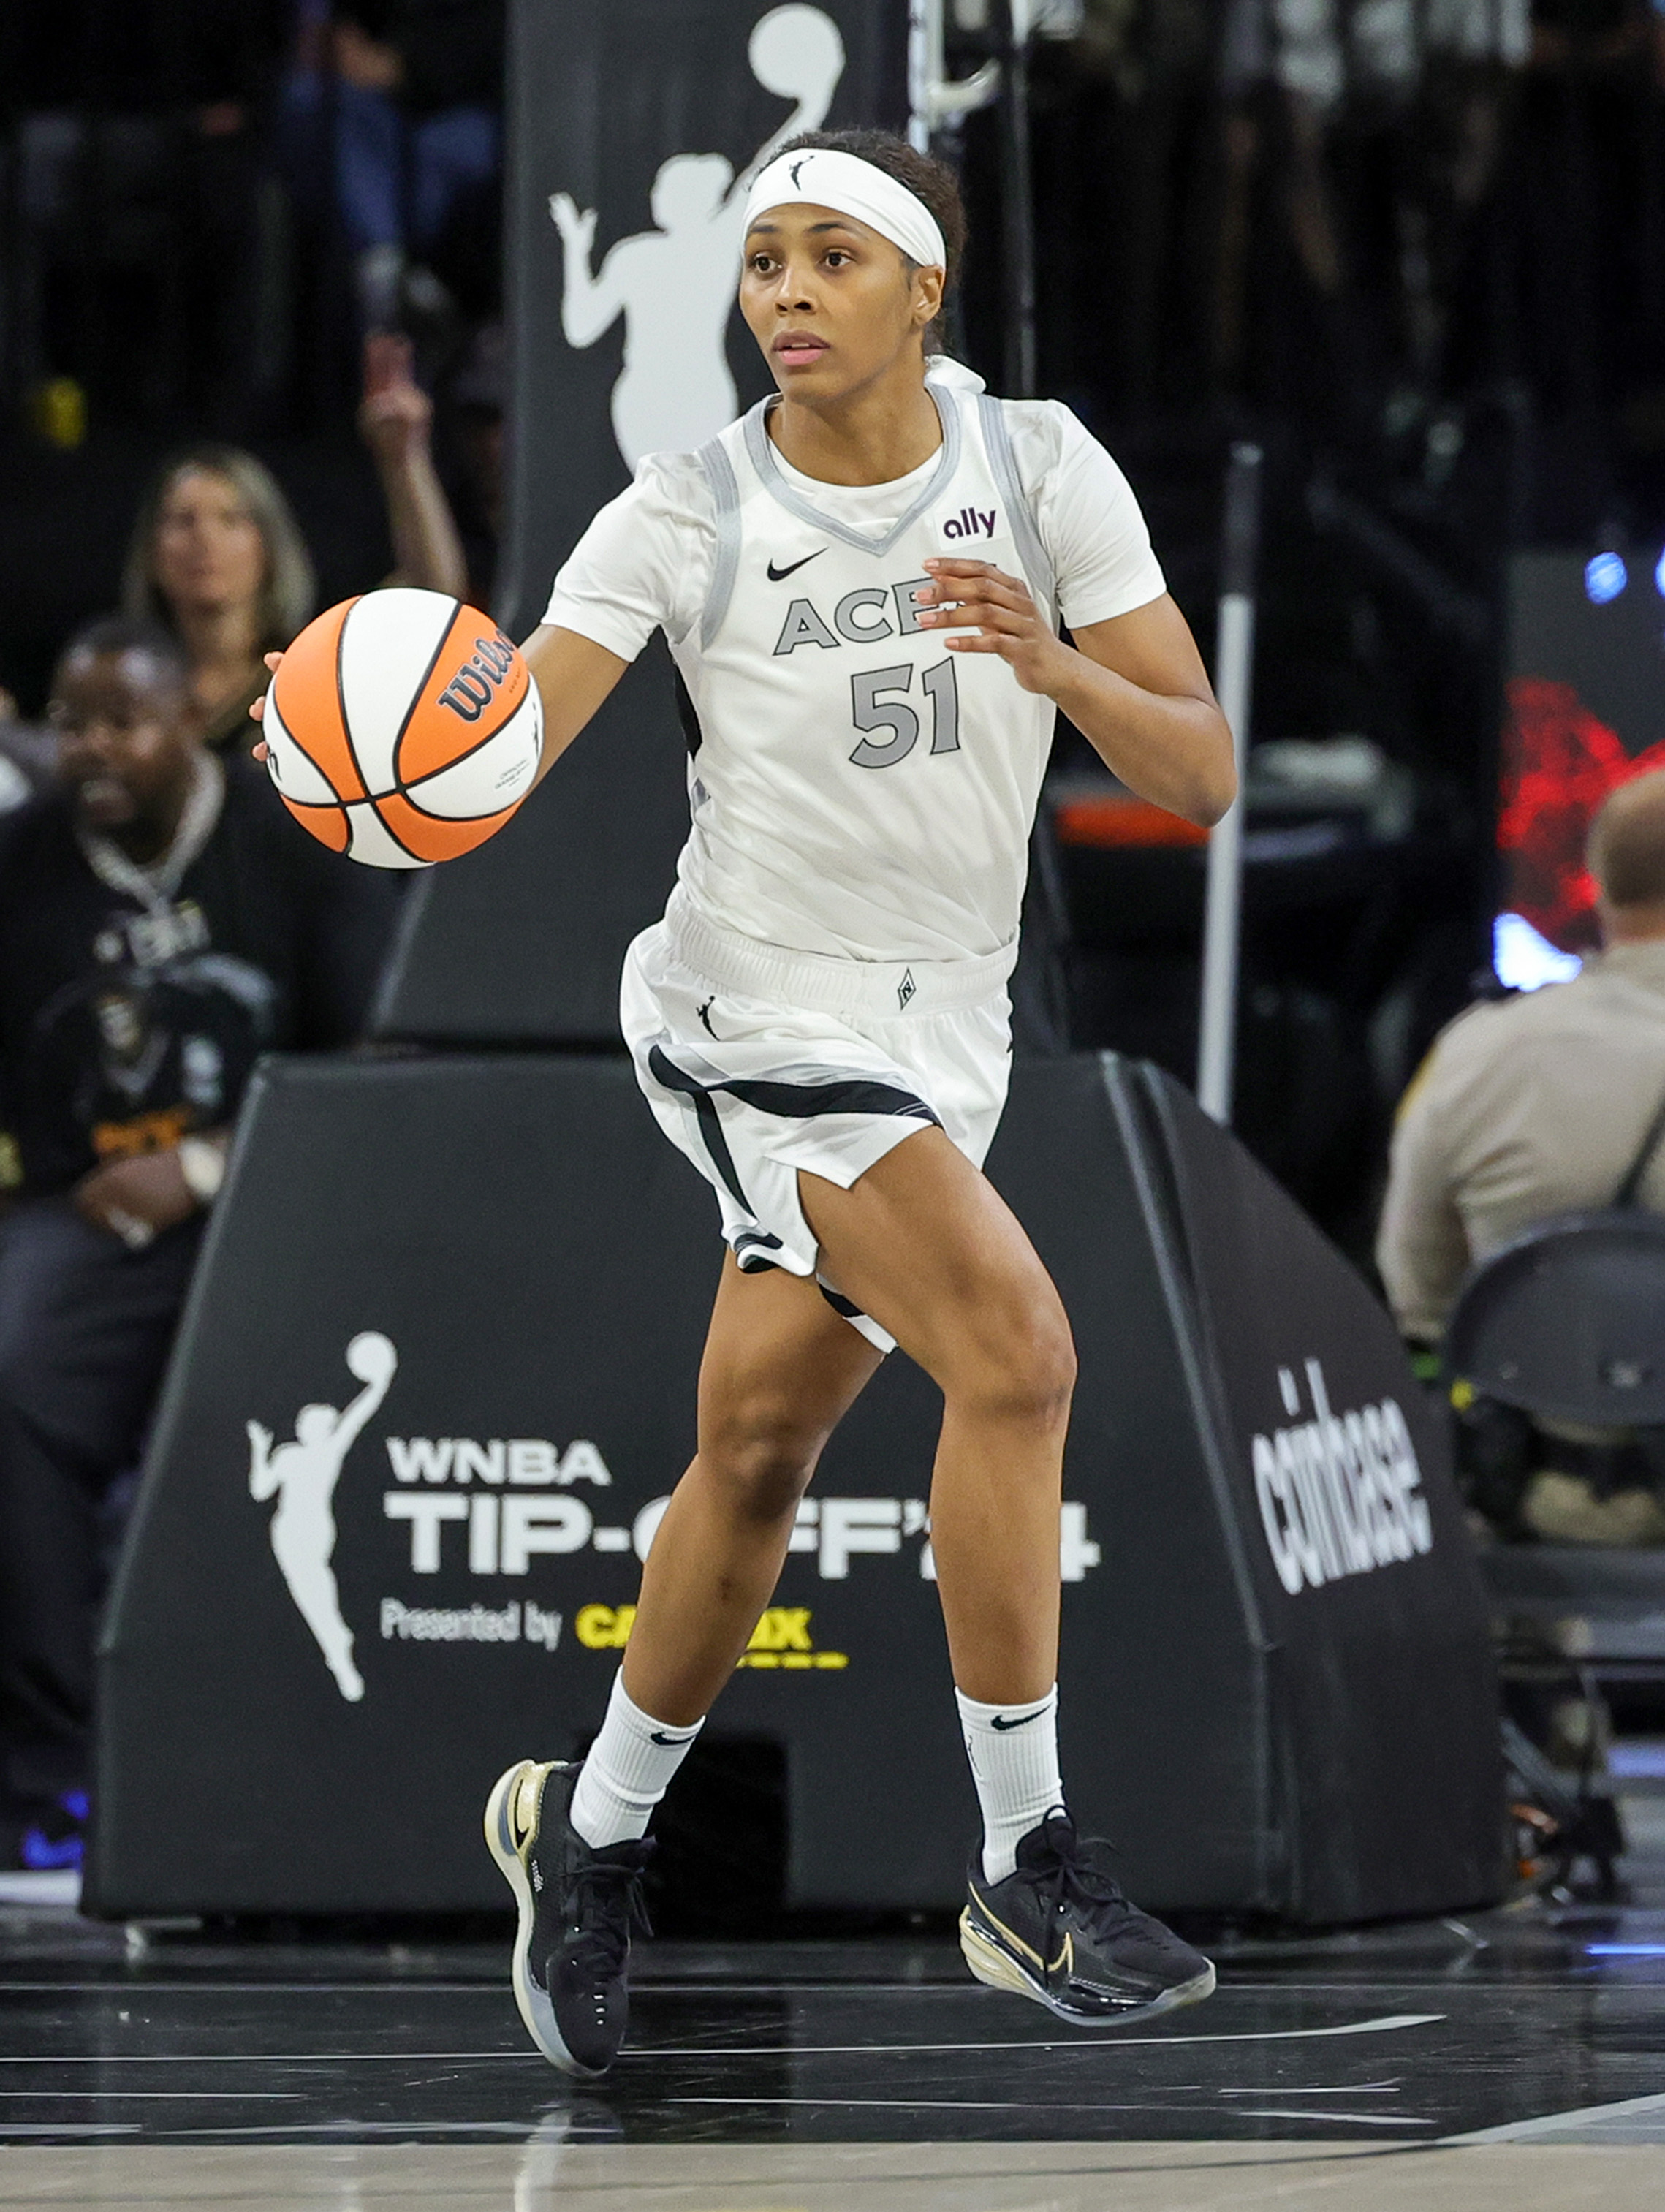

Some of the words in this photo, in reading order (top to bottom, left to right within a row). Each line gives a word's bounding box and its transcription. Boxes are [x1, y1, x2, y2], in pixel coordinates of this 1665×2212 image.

[944, 507, 996, 539] ally
[773, 564, 997, 656] ACE
[849, 655, 961, 769] 51
[385, 1436, 612, 1487] WNBA
[380, 1596, 521, 1643] Presented
[524, 1599, 563, 1653] by
